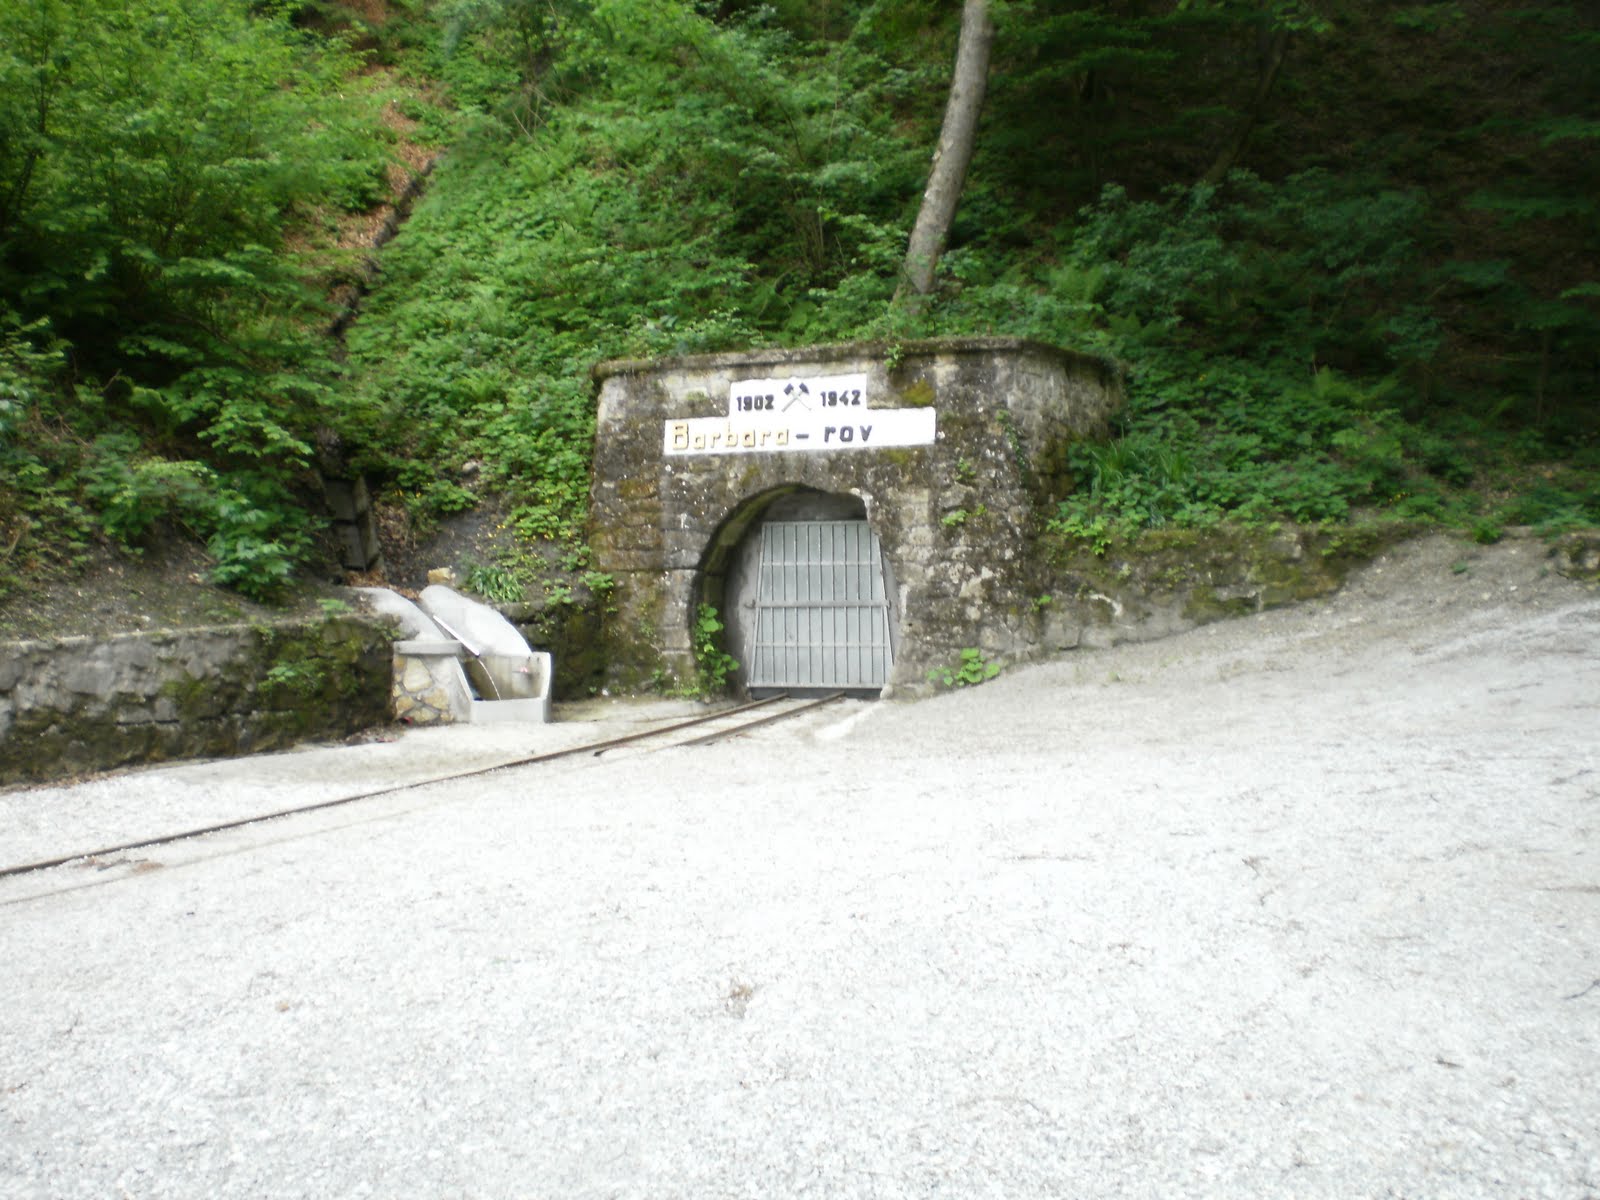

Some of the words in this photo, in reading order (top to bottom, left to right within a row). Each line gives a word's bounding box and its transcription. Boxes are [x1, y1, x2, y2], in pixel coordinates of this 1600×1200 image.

[736, 395, 775, 411] 1902
[820, 389, 861, 407] 1942
[823, 425, 873, 442] rov
